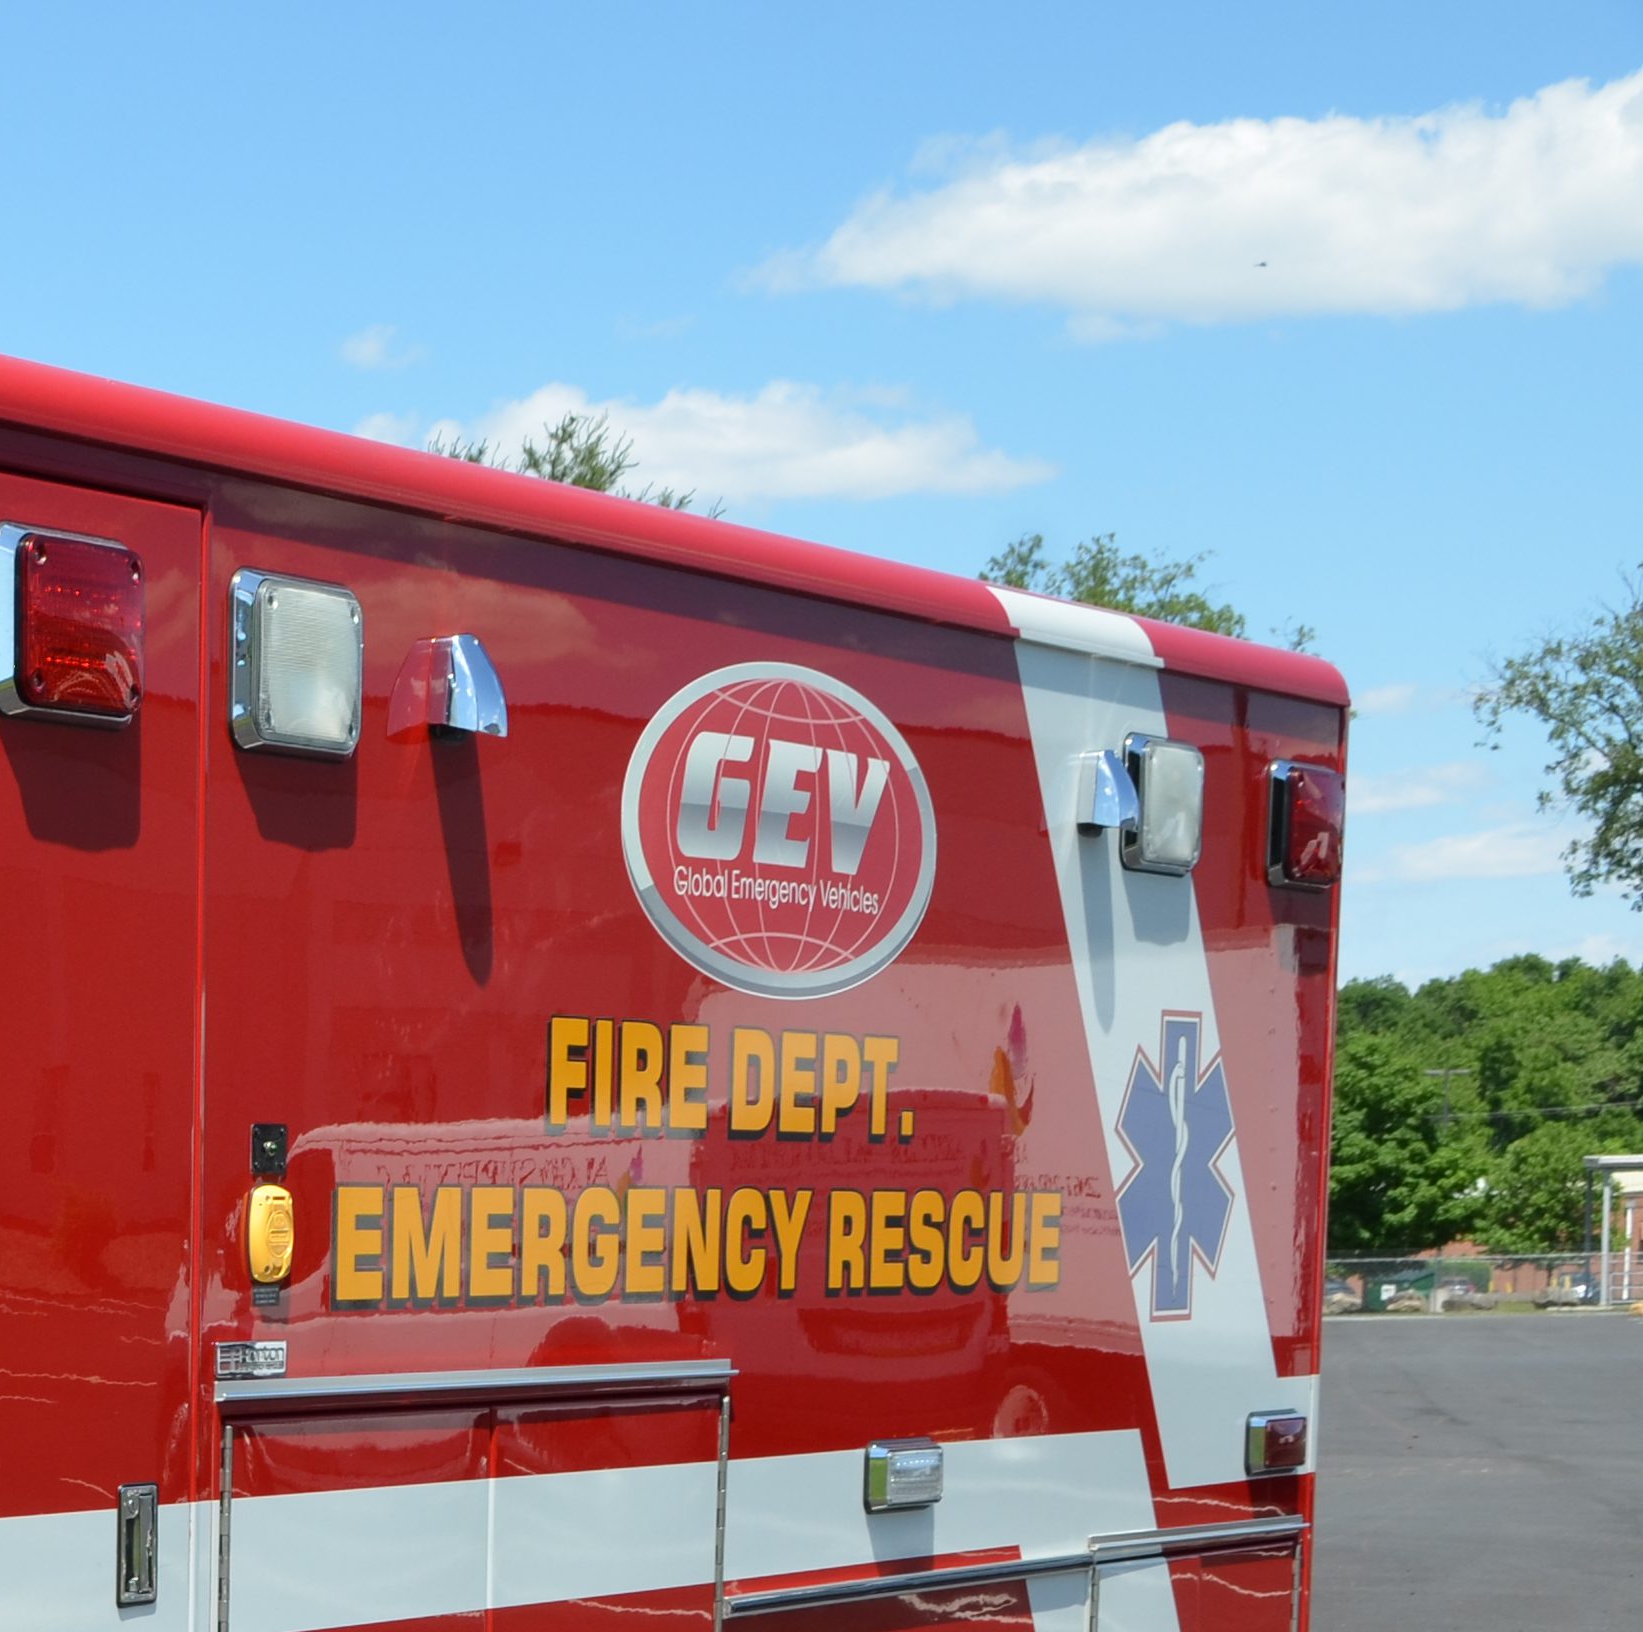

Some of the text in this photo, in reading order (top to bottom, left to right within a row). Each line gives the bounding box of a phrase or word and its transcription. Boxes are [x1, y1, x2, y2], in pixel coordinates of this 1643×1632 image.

[676, 730, 890, 875] GEV
[673, 865, 879, 916] Global Emergency Vehicles
[545, 1015, 915, 1142] FIRE DEPT.
[331, 1184, 1062, 1310] EMERGENCY RESCUE
